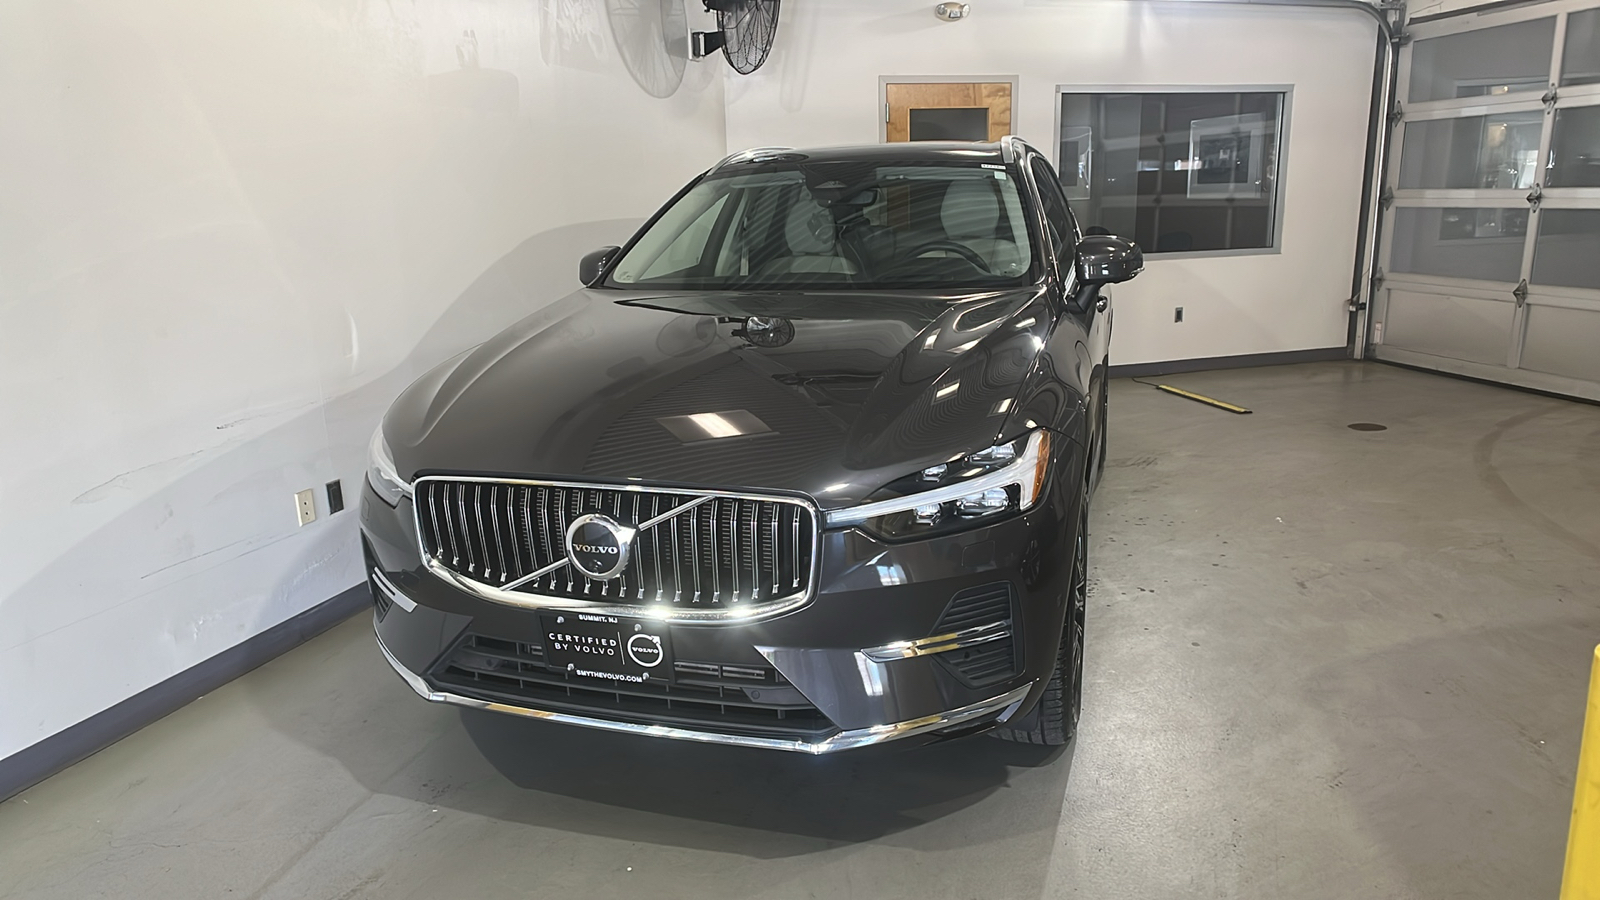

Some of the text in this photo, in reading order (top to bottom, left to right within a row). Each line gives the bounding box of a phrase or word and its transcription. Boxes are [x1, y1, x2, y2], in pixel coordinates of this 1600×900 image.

[573, 543, 618, 554] VOLVO
[548, 632, 617, 646] CERTIFIED
[554, 642, 615, 655] BY VOLVO
[632, 646, 659, 654] VOLVO
[576, 669, 643, 683] SMYTHEVOLVO.COM
